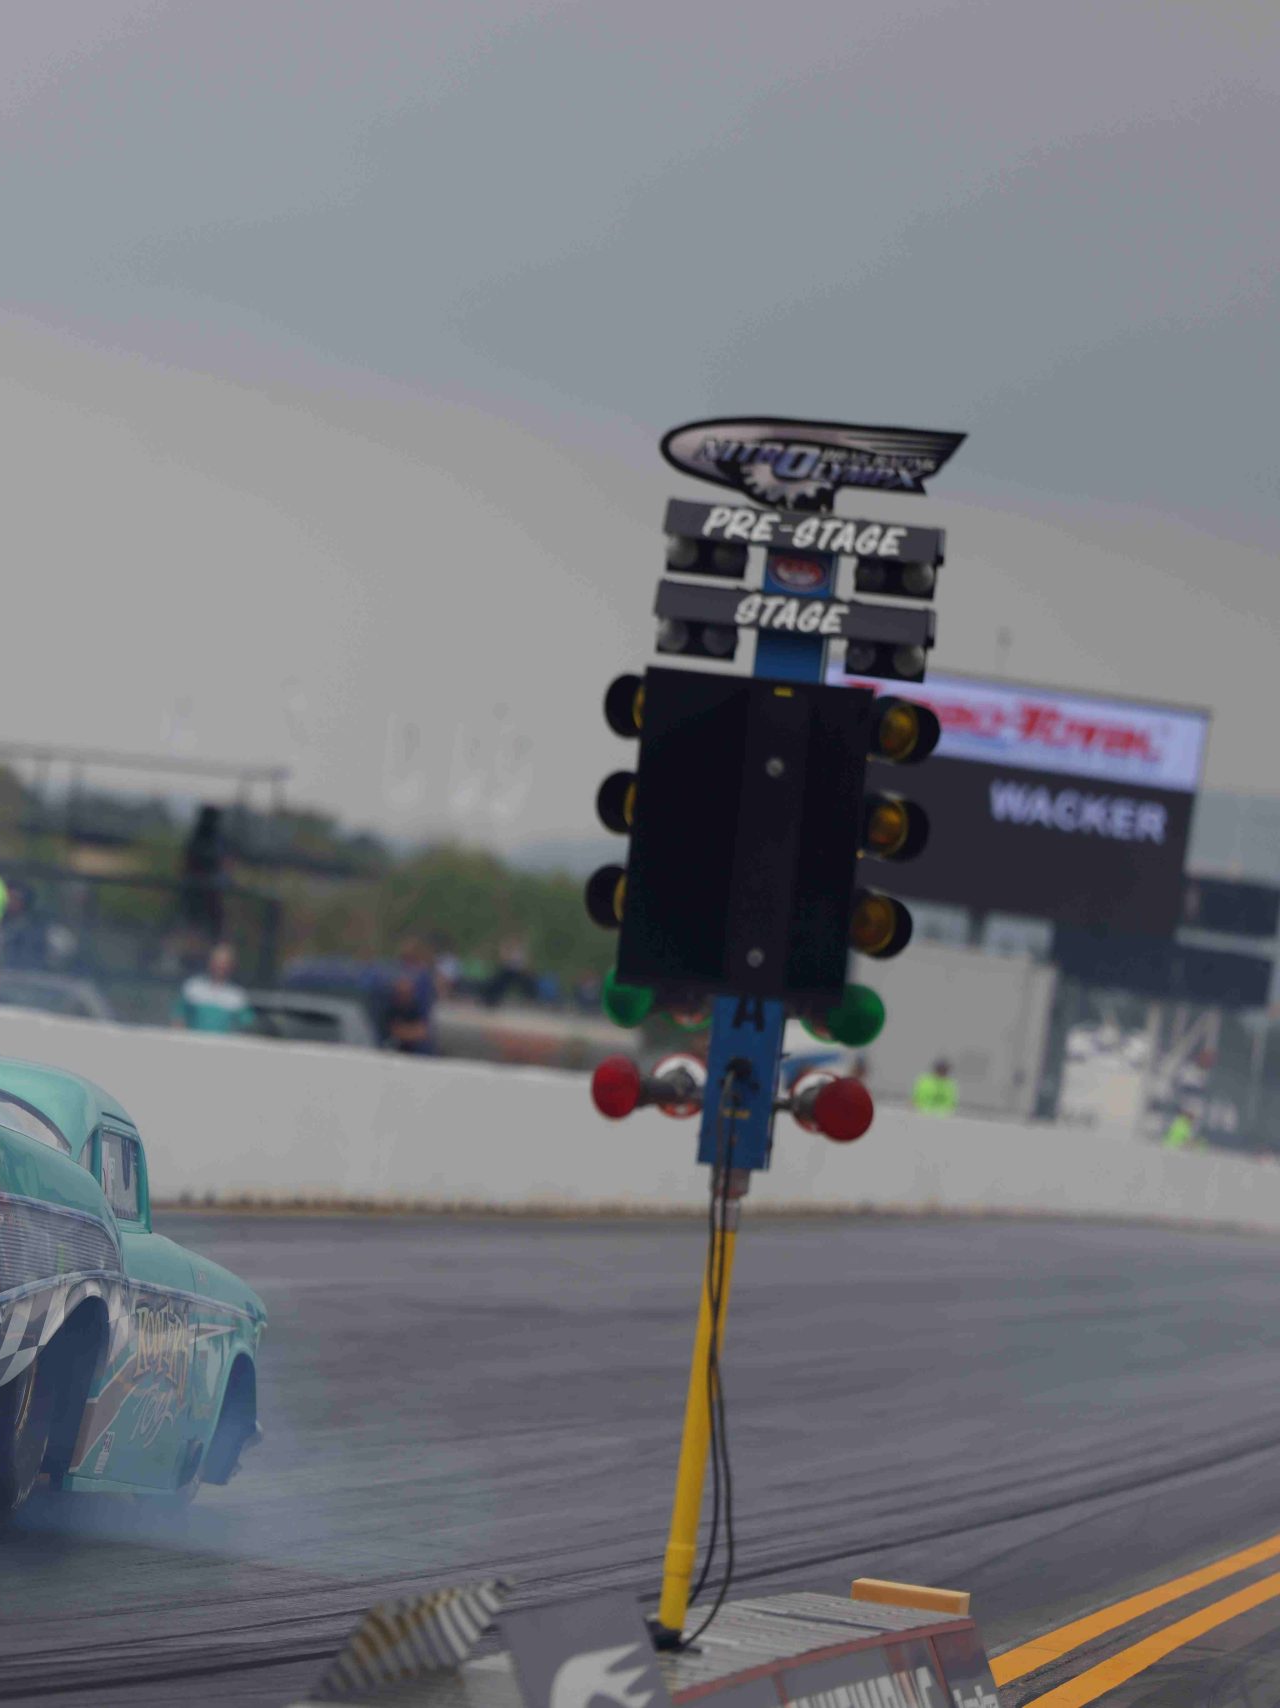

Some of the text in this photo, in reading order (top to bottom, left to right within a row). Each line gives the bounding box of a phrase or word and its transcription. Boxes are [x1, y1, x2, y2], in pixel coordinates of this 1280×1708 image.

[702, 506, 907, 557] PRE-STAGE
[734, 594, 850, 634] STAGE
[989, 779, 1168, 845] WACKER
